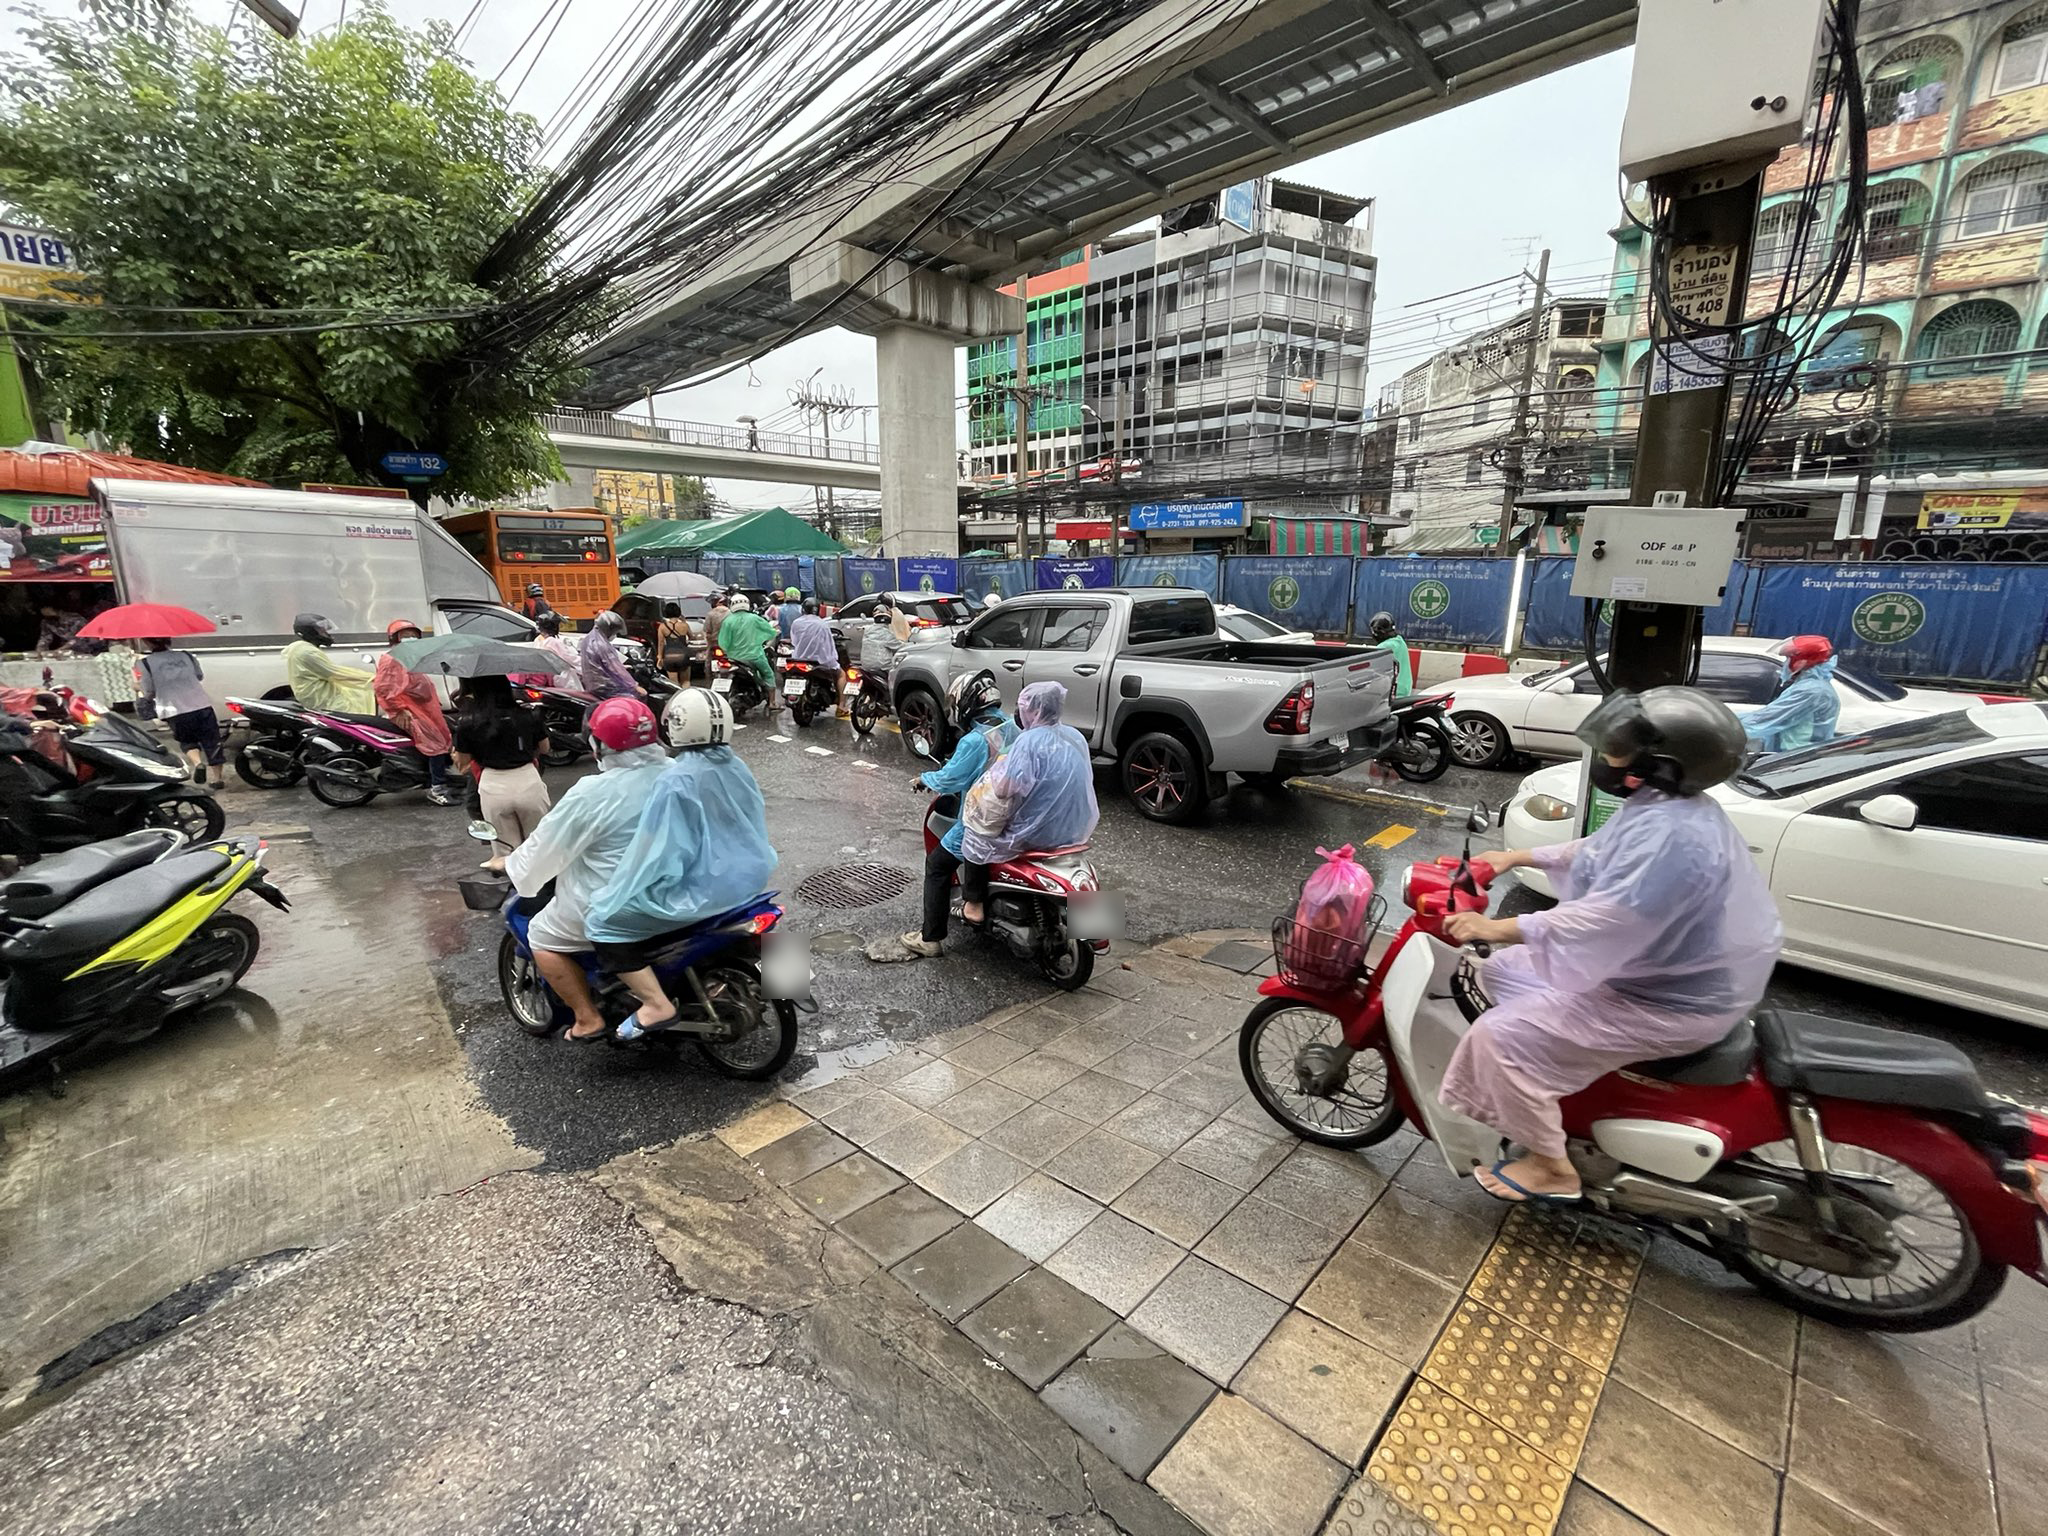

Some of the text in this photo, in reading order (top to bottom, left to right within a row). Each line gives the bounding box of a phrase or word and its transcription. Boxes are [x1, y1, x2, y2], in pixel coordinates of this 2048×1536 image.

[1673, 254, 1733, 274] จำนอง
[1672, 273, 1727, 290] บ้าน ที่ดิน
[1697, 298, 1724, 314] 408
[420, 458, 440, 469] 132
[1641, 541, 1666, 551] ODF
[1688, 543, 1697, 552] P
[1836, 569, 1880, 579] อันตราย
